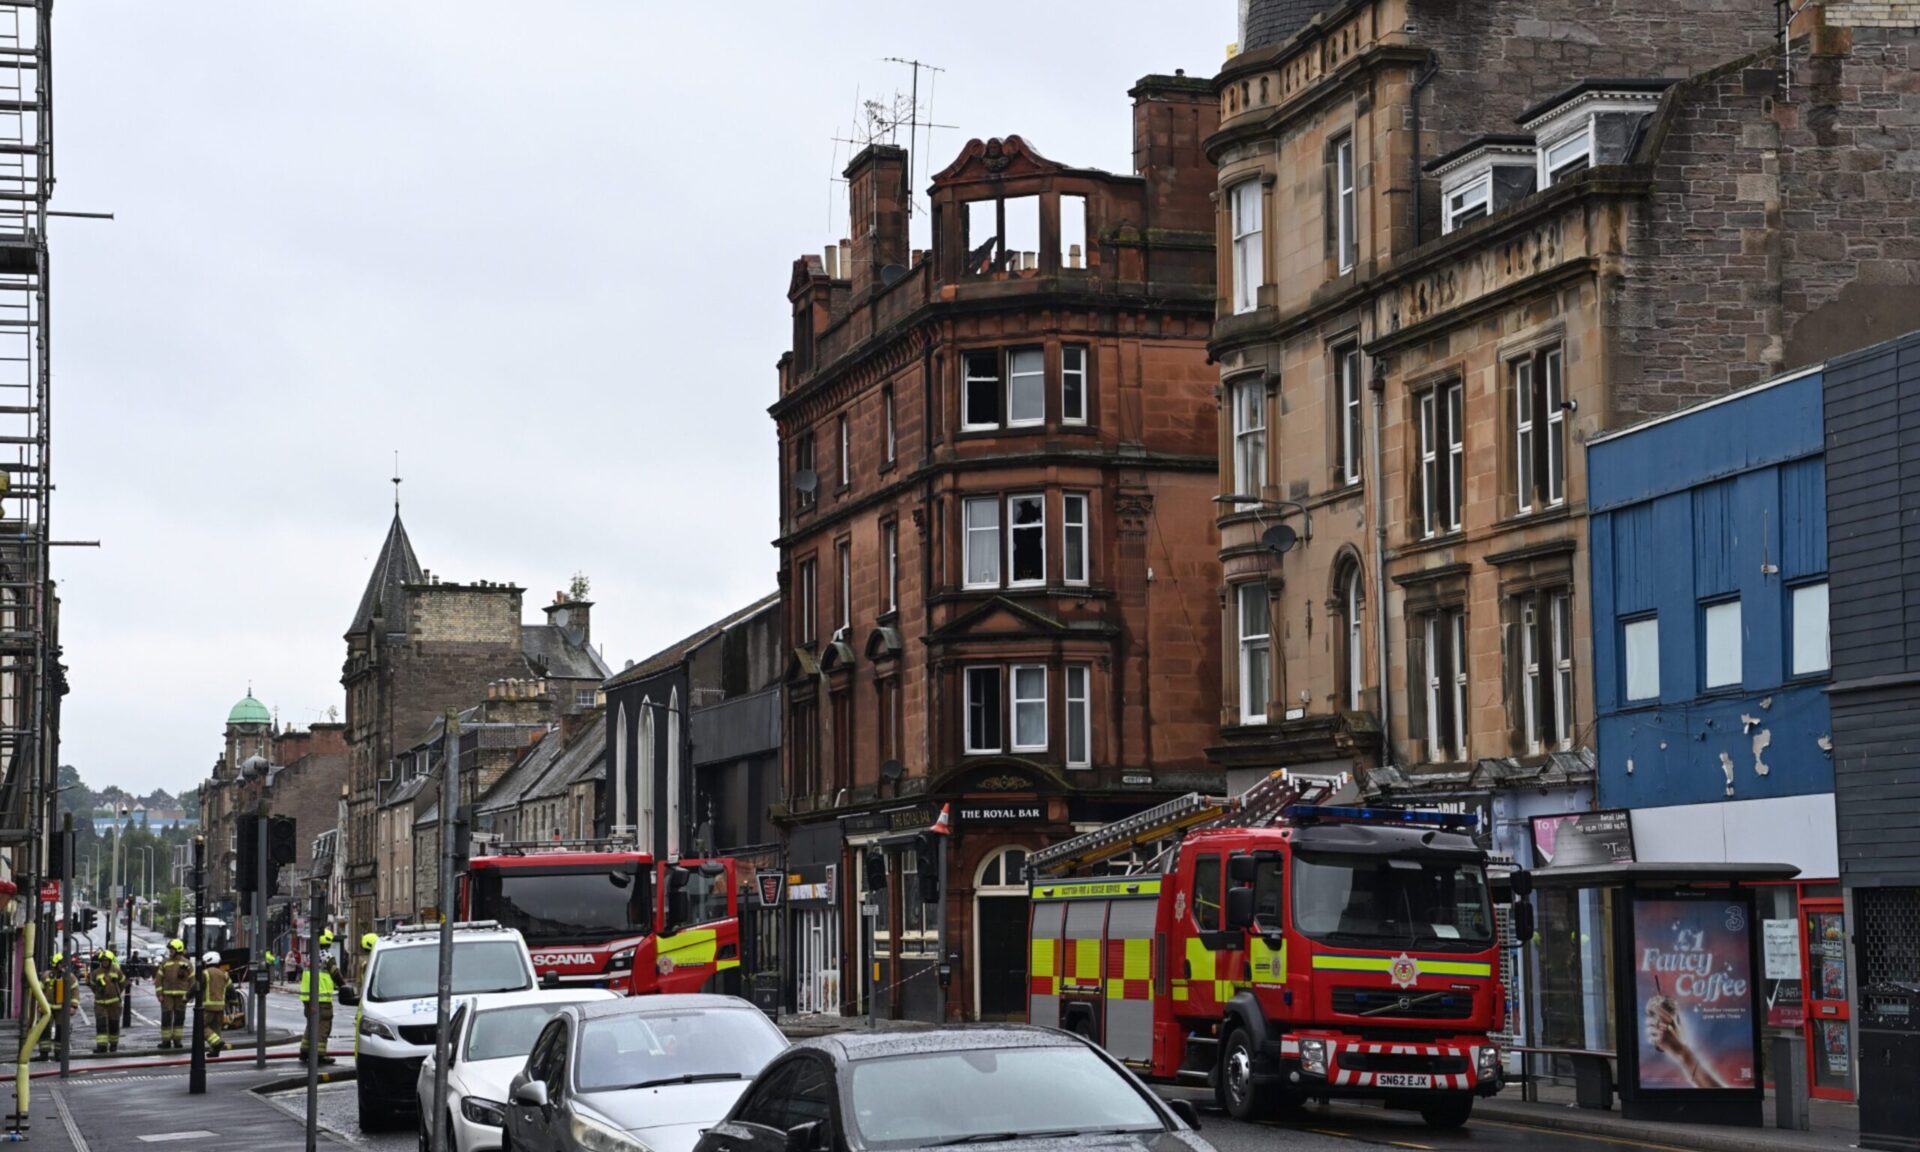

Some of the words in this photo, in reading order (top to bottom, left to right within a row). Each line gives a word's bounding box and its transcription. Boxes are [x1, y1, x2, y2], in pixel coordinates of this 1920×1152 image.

[961, 810, 981, 819] THE
[983, 809, 1016, 819] ROYAL
[1018, 809, 1040, 818] BAR
[1674, 928, 1704, 951] £1
[533, 953, 596, 966] SCANIA
[1641, 948, 1713, 976] Fancy
[1675, 972, 1747, 1002] Coffee
[1380, 1075, 1406, 1086] SN62
[1408, 1075, 1427, 1086] EJX
